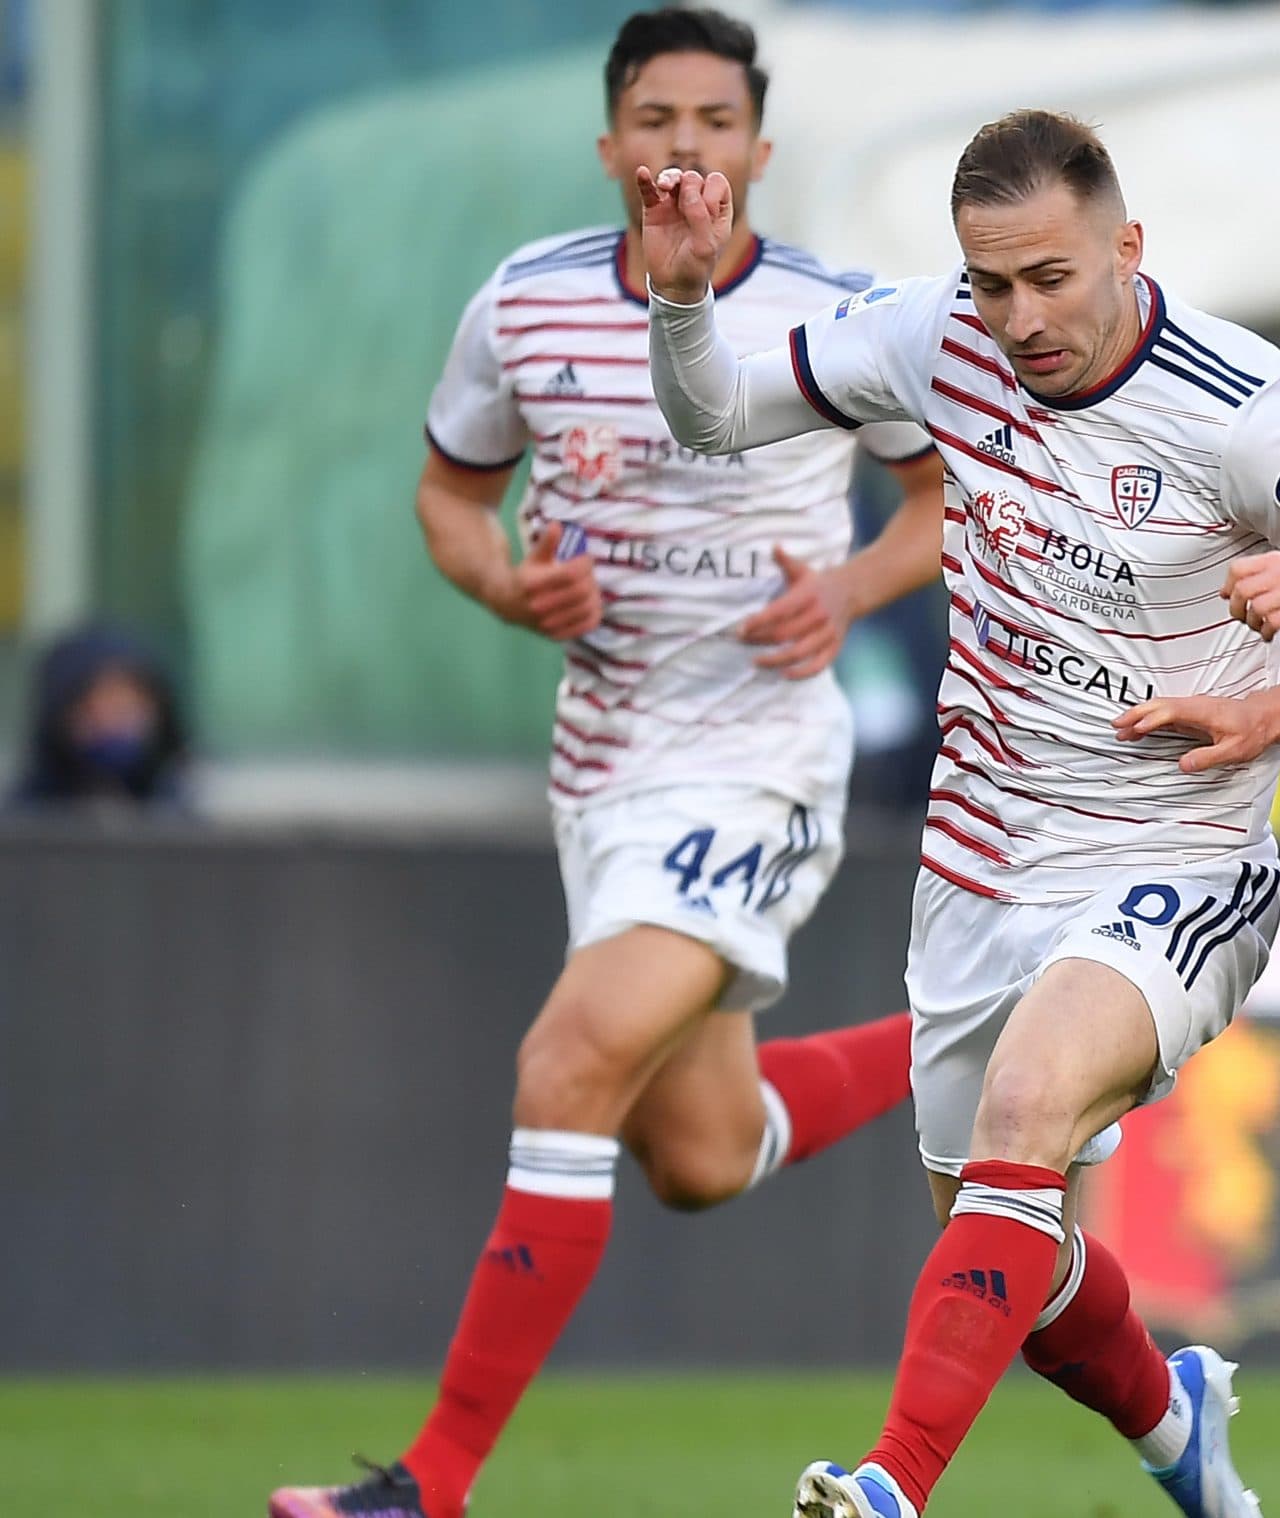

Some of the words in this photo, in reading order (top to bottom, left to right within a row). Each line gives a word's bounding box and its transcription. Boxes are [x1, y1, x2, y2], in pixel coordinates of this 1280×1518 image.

[977, 439, 1017, 466] adidas
[604, 537, 759, 578] TISCALI
[1041, 530, 1136, 587] ISOLA
[1033, 579, 1047, 595] DI
[1051, 590, 1137, 621] SARDEGNA
[1034, 564, 1137, 605] ARTIGIANATO
[1090, 927, 1142, 952] adidas
